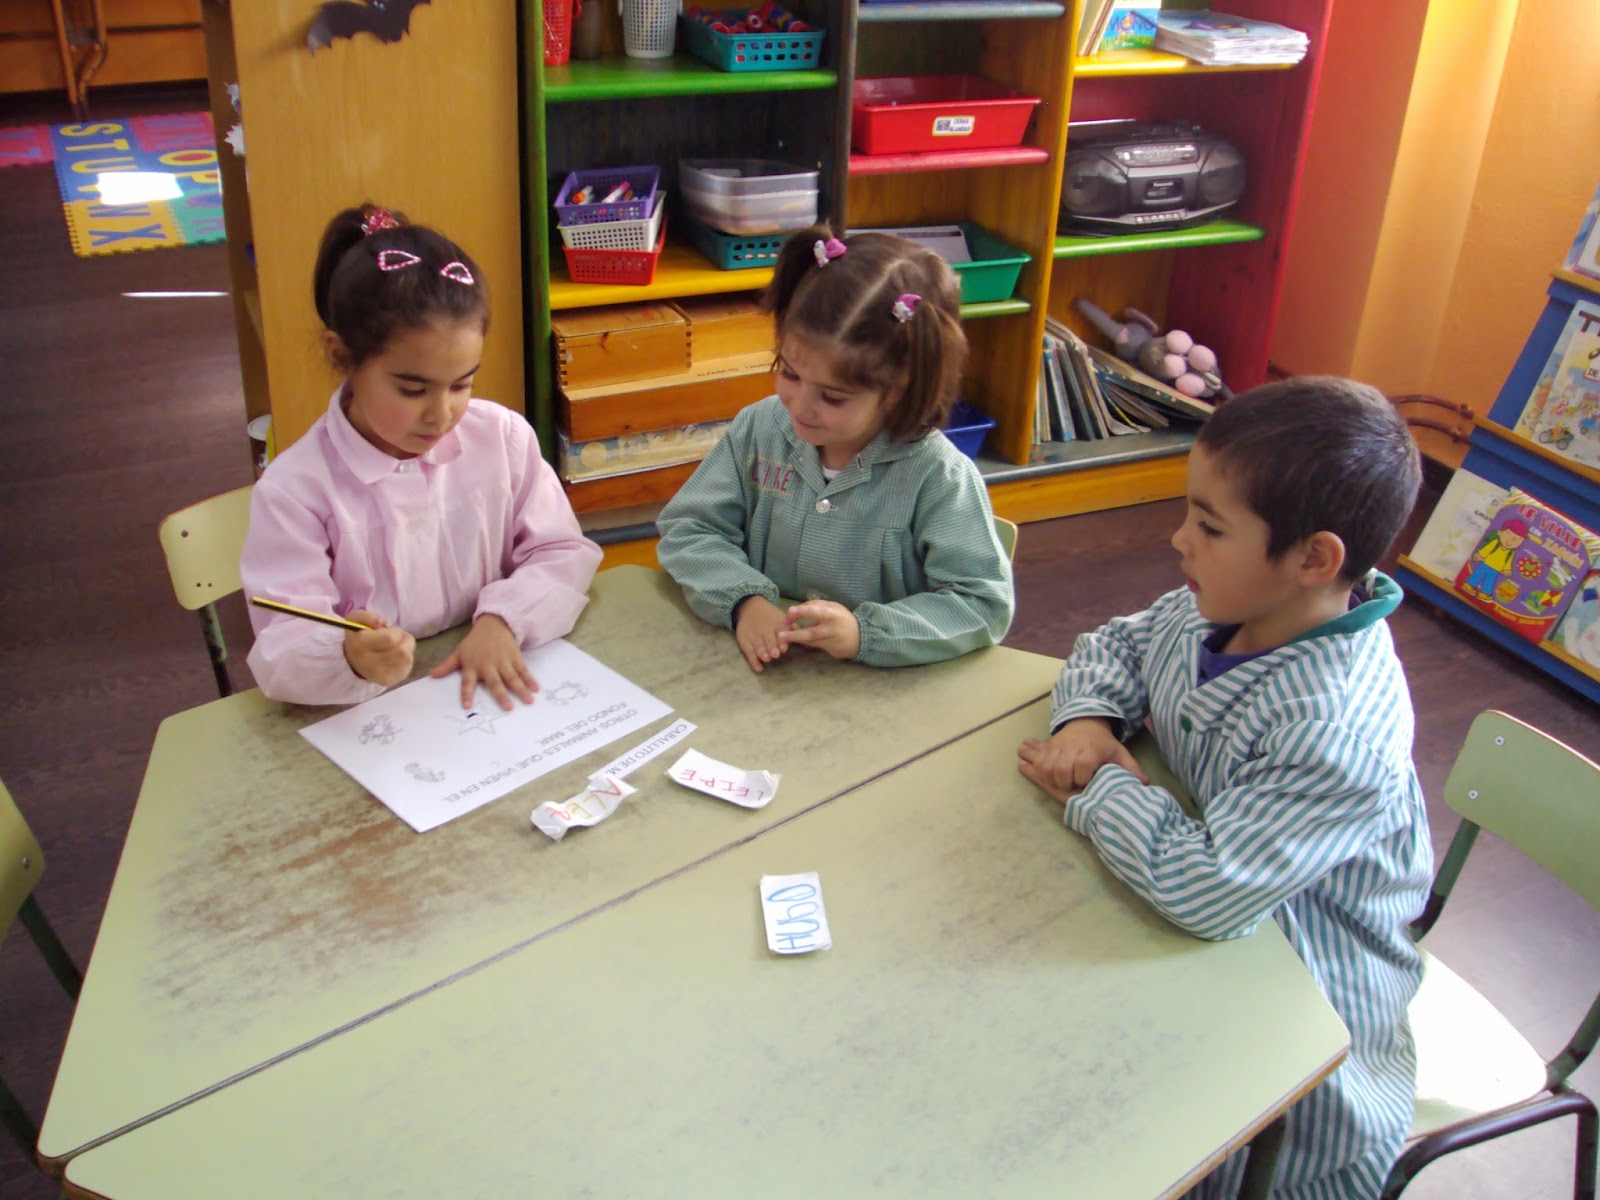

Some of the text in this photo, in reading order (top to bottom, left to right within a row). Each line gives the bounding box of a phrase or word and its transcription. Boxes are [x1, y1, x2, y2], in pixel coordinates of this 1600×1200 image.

[599, 708, 638, 729] OTROS
[568, 720, 589, 732] DEL
[543, 728, 599, 756] ANIMALES
[634, 723, 687, 758] CABALLITO
[516, 754, 543, 769] QUE
[620, 756, 636, 768] DE
[460, 783, 480, 797] EN
[443, 793, 461, 803] EL
